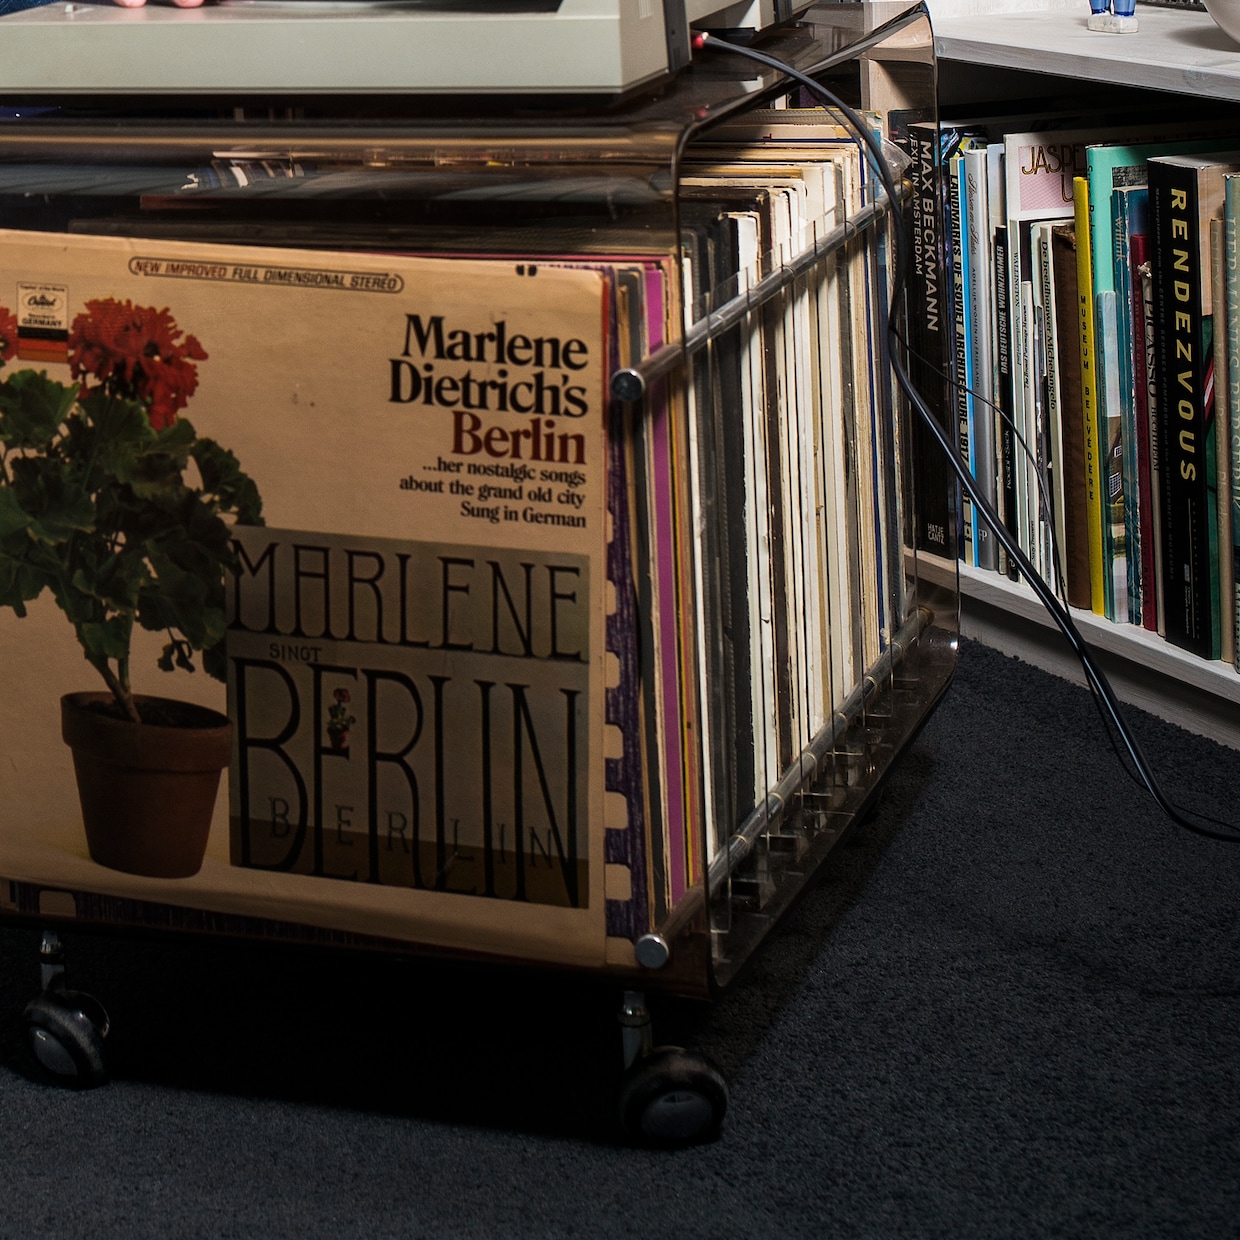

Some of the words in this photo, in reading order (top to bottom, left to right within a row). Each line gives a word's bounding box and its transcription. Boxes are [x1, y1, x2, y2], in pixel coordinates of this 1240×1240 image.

[910, 139, 919, 168] EXIL
[912, 171, 920, 180] IN
[921, 141, 934, 192] MAX
[913, 191, 922, 275] AMSTERDAM
[950, 174, 961, 256] LANDMARKS
[1114, 216, 1125, 262] Willink
[923, 197, 938, 333] BECKMANN
[954, 261, 963, 278] OF
[1041, 240, 1049, 256] De
[134, 261, 160, 274] NEW
[165, 264, 227, 278] IMPROVED
[232, 267, 259, 281] FULL
[264, 270, 345, 287] DIMENSIONAL
[350, 276, 397, 291] STEREO
[996, 245, 1006, 310] WOHNZIMMER
[1043, 259, 1052, 333] beeldhouwer
[1226, 217, 1240, 370] HERMANUS
[22, 317, 62, 327] GERMANY
[955, 283, 964, 328] SOVIET
[998, 311, 1007, 353] DEUTSCHE
[401, 313, 589, 371] Marlene
[974, 331, 979, 341] IN
[1080, 294, 1090, 371] MUSEUM
[1145, 299, 1157, 398] PICASSO
[1170, 187, 1198, 481] RENDEZVOUS
[388, 358, 589, 418] Dietrich's
[956, 337, 969, 432] ARCHITECTURE
[1000, 355, 1008, 374] DAS
[1046, 335, 1057, 410] Michelangelo
[451, 410, 587, 465] Berlin
[399, 475, 444, 494] about
[449, 479, 474, 496] the
[477, 483, 523, 501] grand
[527, 487, 553, 505] old
[557, 490, 586, 509] city
[467, 461, 535, 483] nostalgic
[540, 469, 587, 488] songs
[460, 501, 500, 524] Sung
[504, 506, 519, 522] in
[522, 507, 587, 528] German
[927, 522, 944, 533] HATJE
[1218, 470, 1227, 537] Phaidon
[927, 531, 946, 544] CANTZ
[228, 538, 589, 665] MARLENE
[268, 643, 322, 662] SINGT
[231, 658, 582, 910] BERLIN
[268, 796, 554, 869] BERLIN
